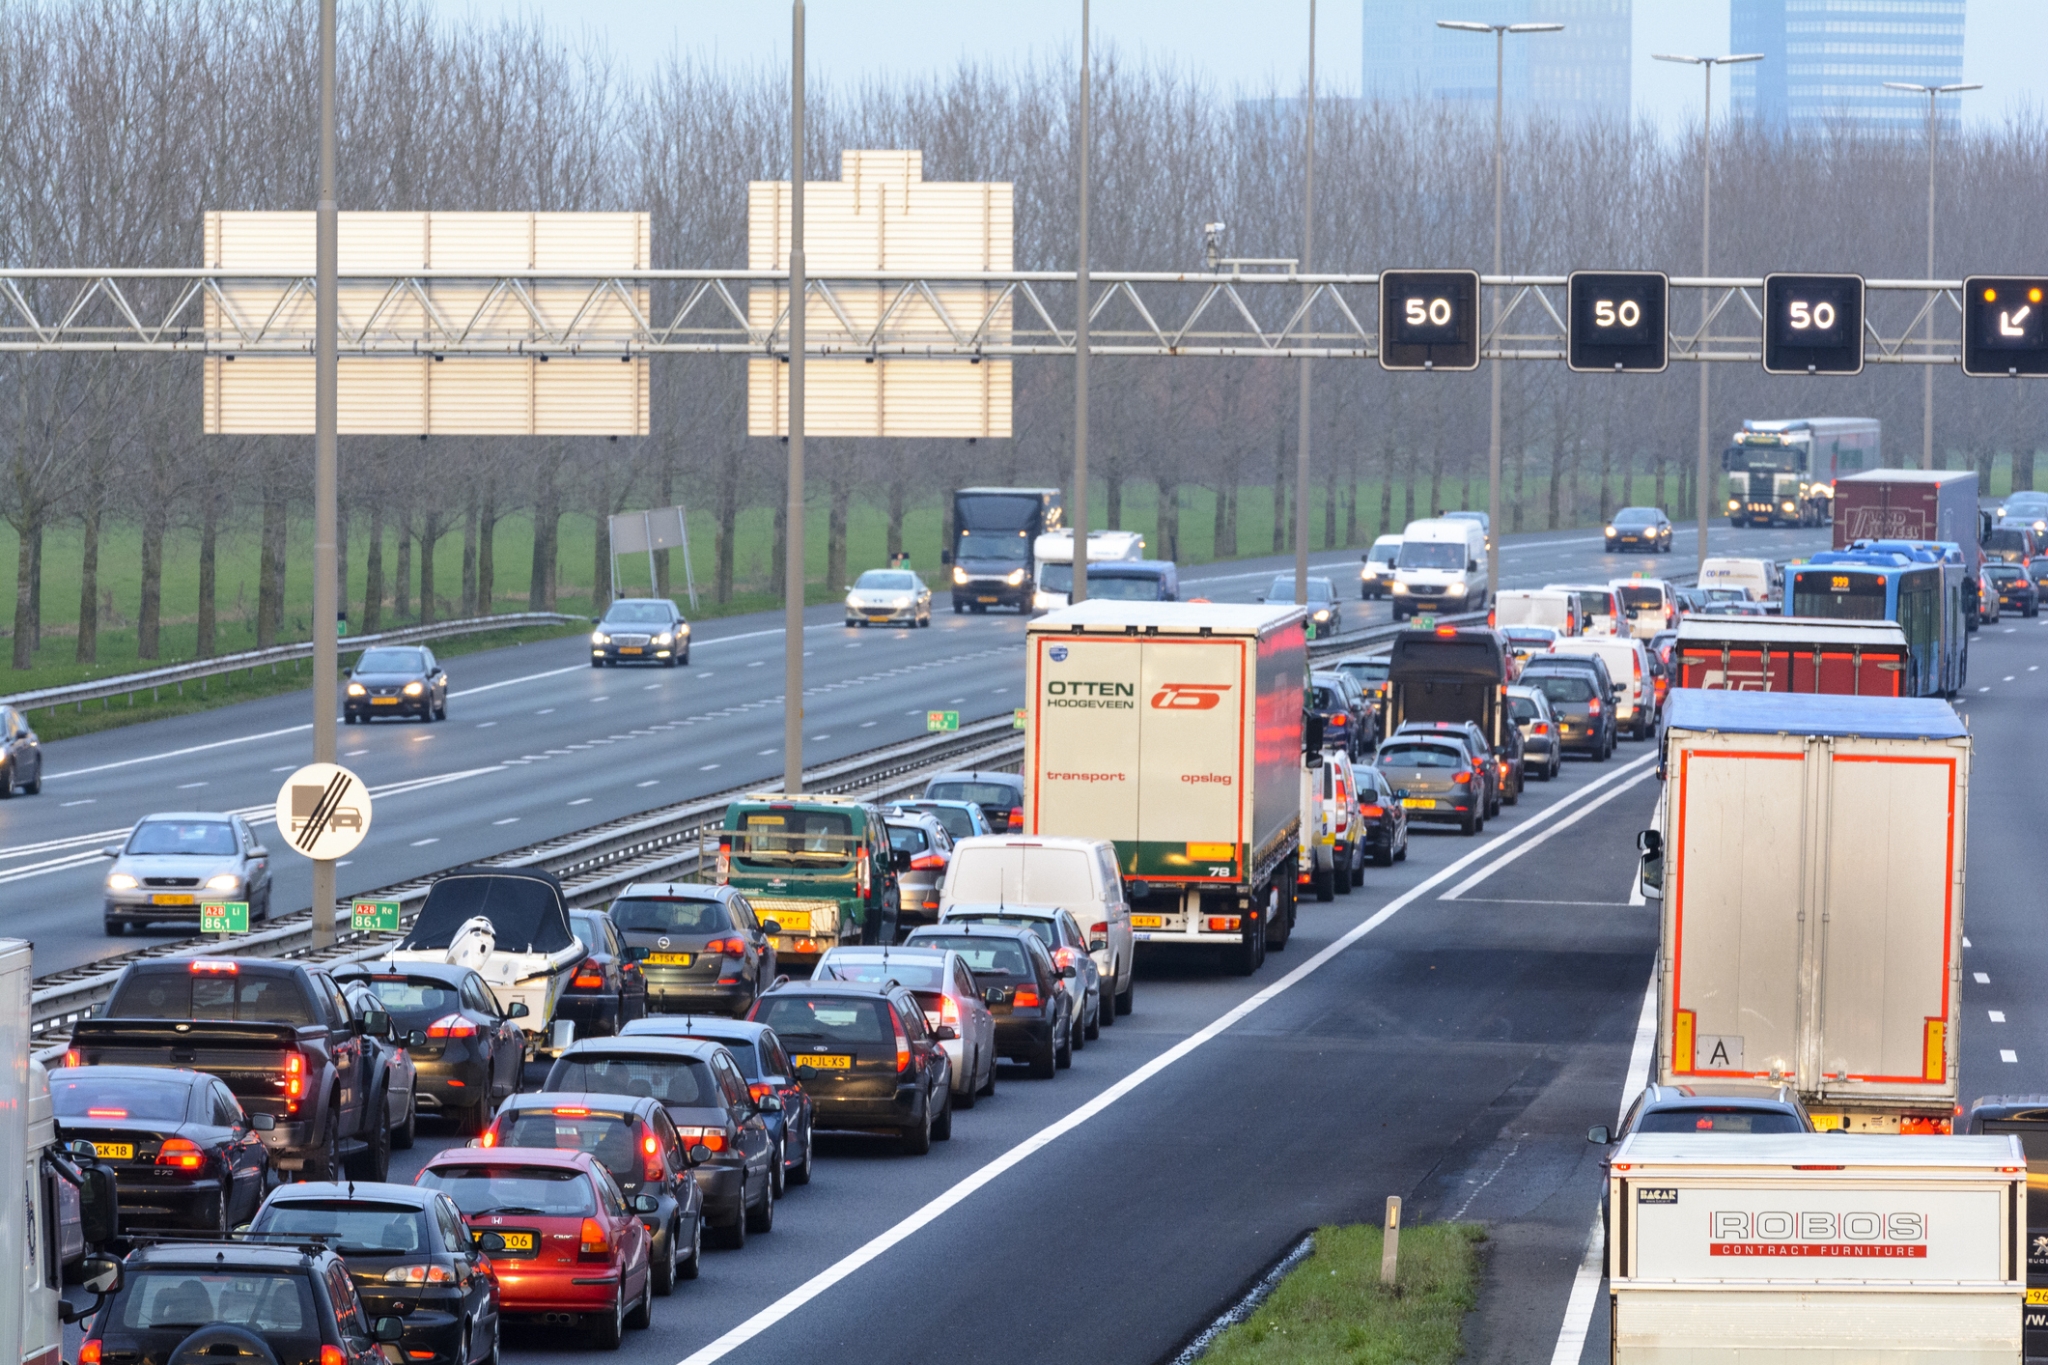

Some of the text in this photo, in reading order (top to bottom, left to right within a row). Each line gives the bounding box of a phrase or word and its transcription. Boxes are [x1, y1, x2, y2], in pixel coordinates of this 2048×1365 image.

[1405, 298, 1451, 326] 50
[1595, 300, 1641, 327] 50
[1790, 302, 1836, 329] 50
[1832, 576, 1849, 587] 999
[1048, 680, 1134, 697] OTTEN
[1047, 699, 1134, 709] HOOGEVEEN
[1047, 771, 1126, 783] transport
[1181, 773, 1232, 785] opslag
[1208, 867, 1230, 877] 78
[205, 906, 241, 916] A28 Li
[356, 904, 393, 915] A28 Re
[204, 918, 231, 929] 86,1
[355, 916, 382, 928] 86,1
[1709, 1039, 1730, 1065] A
[801, 1056, 845, 1067] 01-JL-XS
[96, 1144, 128, 1156] GK-18
[1640, 1189, 1677, 1200] BACAR
[1714, 1210, 1923, 1241] ROBOS
[1722, 1244, 1915, 1257] CONTRACT FURNITURE
